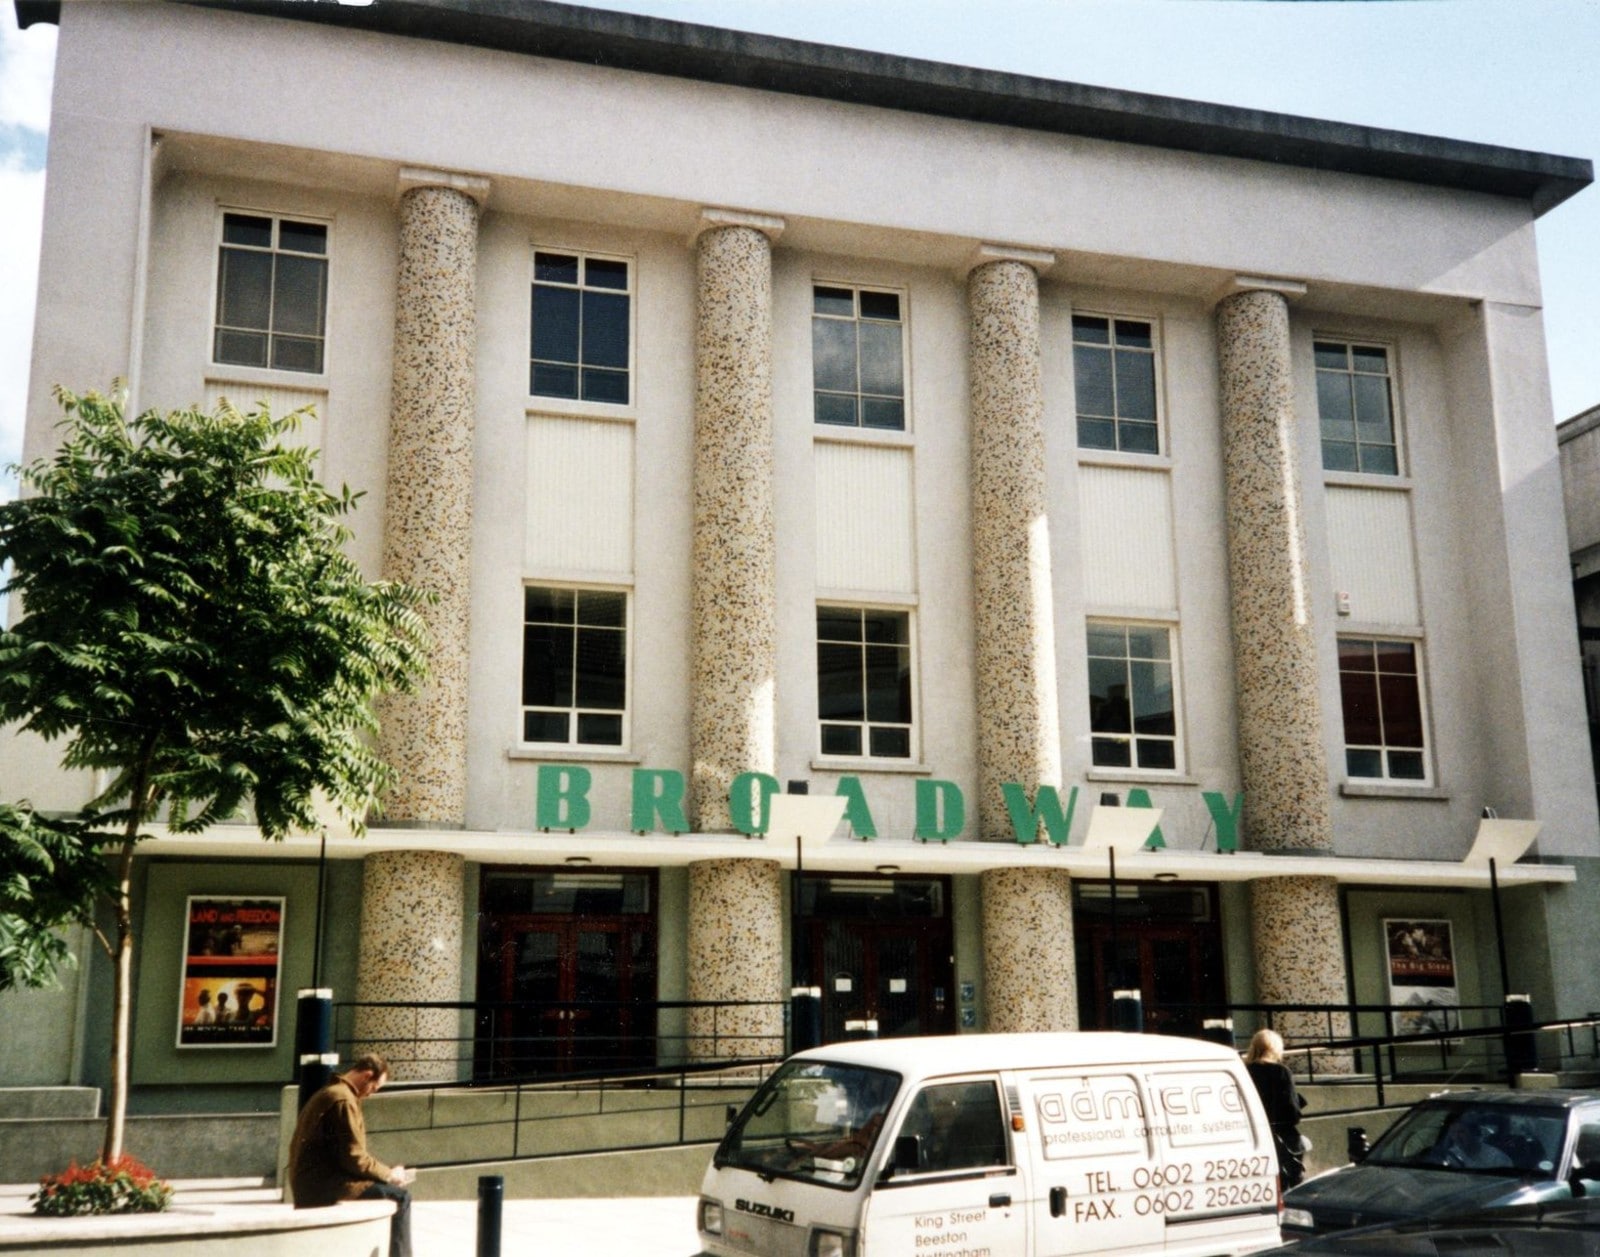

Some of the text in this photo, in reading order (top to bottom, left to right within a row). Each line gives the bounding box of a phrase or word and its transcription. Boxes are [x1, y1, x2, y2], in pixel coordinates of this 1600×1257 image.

[1042, 1126, 1126, 1147] professional
[1085, 1156, 1270, 1194] TEL. 0602 252627
[735, 1198, 795, 1223] SUZUKI
[1074, 1183, 1274, 1223] FAX. 0602 252626
[915, 1210, 987, 1229] King Street
[915, 1231, 968, 1247] Beeston
[915, 1247, 991, 1257] ttingham
